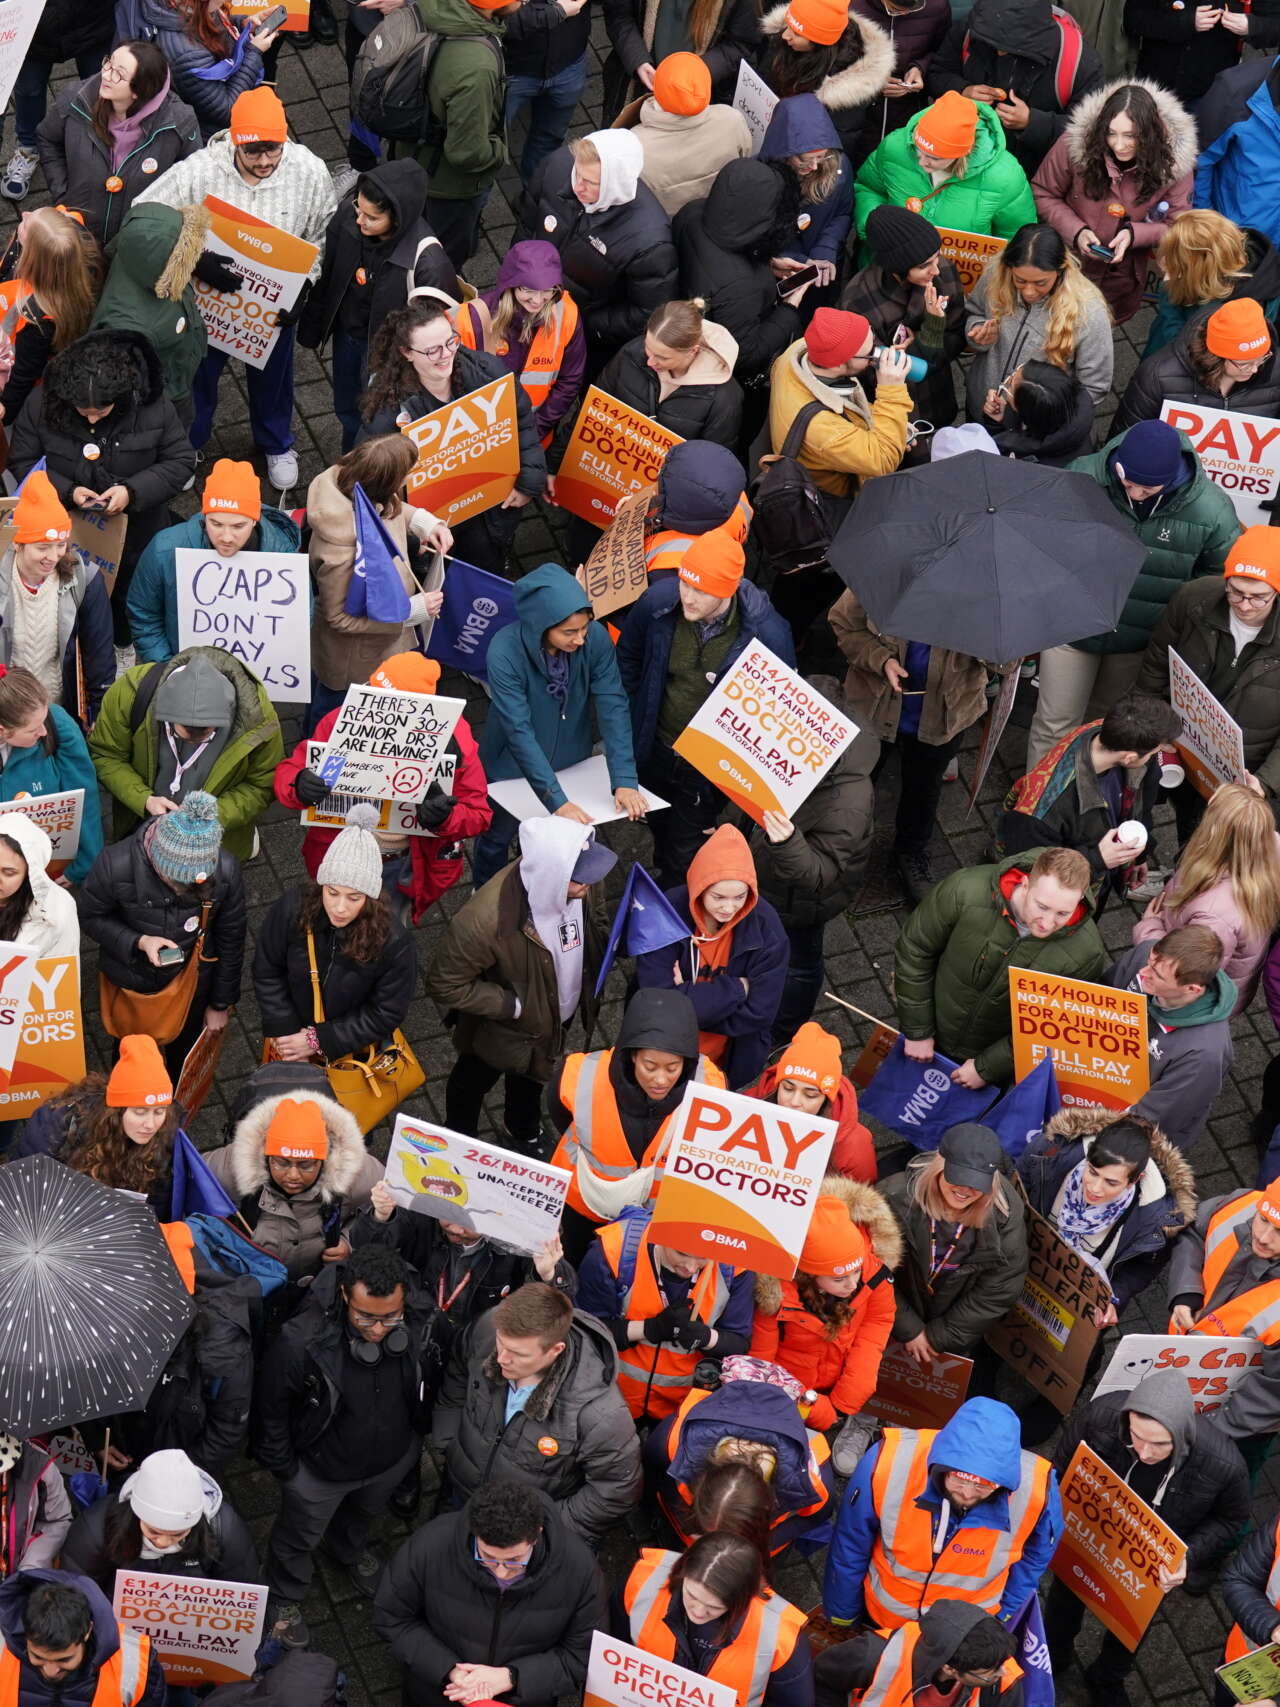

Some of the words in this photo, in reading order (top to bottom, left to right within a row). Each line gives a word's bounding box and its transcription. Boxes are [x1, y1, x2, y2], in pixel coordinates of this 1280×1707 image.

[408, 382, 508, 450] PAY
[592, 397, 673, 450] £14/HOUR
[579, 425, 659, 482] DOCTO
[1167, 408, 1280, 464] PAY
[411, 428, 513, 488] DOCTORS
[581, 450, 625, 487] FULL
[1249, 466, 1274, 477] FOR
[217, 498, 239, 510] BMA
[192, 561, 297, 606] CLAPS
[1245, 564, 1267, 578] BMA
[193, 609, 285, 636] DON'T
[453, 612, 490, 654] BMA
[359, 692, 418, 715] THERE'S
[421, 703, 435, 716] A
[734, 670, 766, 700] FOR
[776, 709, 833, 759] JUNIOR
[741, 661, 769, 686] NOT
[777, 692, 806, 719] FAIR
[805, 715, 840, 750] WAGE
[749, 652, 831, 726] £14/HOUR
[829, 722, 849, 741] IS
[337, 720, 398, 742] JUNIOR
[343, 705, 409, 728] REASON
[415, 717, 450, 734] 30%
[722, 680, 825, 774] DOCTOR
[329, 748, 351, 758] THE
[339, 738, 368, 754] ARE
[370, 742, 439, 764] LEAVING!
[715, 718, 773, 770] RESTORATION
[719, 706, 763, 752] FULL
[766, 748, 802, 781] PAY
[60, 797, 77, 807] IS
[1017, 978, 1117, 1010] £14/HOUR
[1123, 1000, 1140, 1015] IS
[1017, 991, 1048, 1006] NOT
[1063, 1001, 1096, 1017] FAIR
[1098, 1009, 1140, 1027] WAGE
[47, 1010, 76, 1024] FOR
[1018, 1003, 1054, 1021] FOR
[1075, 1014, 1140, 1040] JUNIOR
[1019, 1015, 1141, 1060] DOCTOR
[794, 1065, 818, 1081] BMA
[1091, 1056, 1132, 1078] PAY
[897, 1083, 941, 1128] BMA
[292, 1146, 315, 1158] BMA
[682, 1097, 825, 1171] PAY
[502, 1160, 529, 1178] PAY
[673, 1155, 809, 1207] DOCTORS
[679, 1143, 780, 1179] RESTORATION
[782, 1172, 814, 1189] FOR
[477, 1171, 565, 1206] UNACCEPTABLE
[845, 1256, 865, 1272] BMA
[1028, 1256, 1096, 1329] CLEAR
[1009, 1339, 1068, 1390] OFF
[1081, 1456, 1160, 1538] £14/HOUR
[962, 1548, 986, 1556] BMA
[1064, 1482, 1160, 1587] DOCTOR
[122, 1588, 156, 1598] NOT
[175, 1594, 210, 1606] FAIR
[213, 1598, 258, 1610] WAGE
[124, 1578, 235, 1600] £14/HOUR
[241, 1591, 259, 1601] IS
[120, 1605, 259, 1634] DOCTOR
[121, 1597, 161, 1609] FOR
[183, 1605, 257, 1621] JUNIOR
[196, 1634, 240, 1649] PAY
[207, 1645, 239, 1656] NOW
[602, 1648, 715, 1707] OFFICIAL
